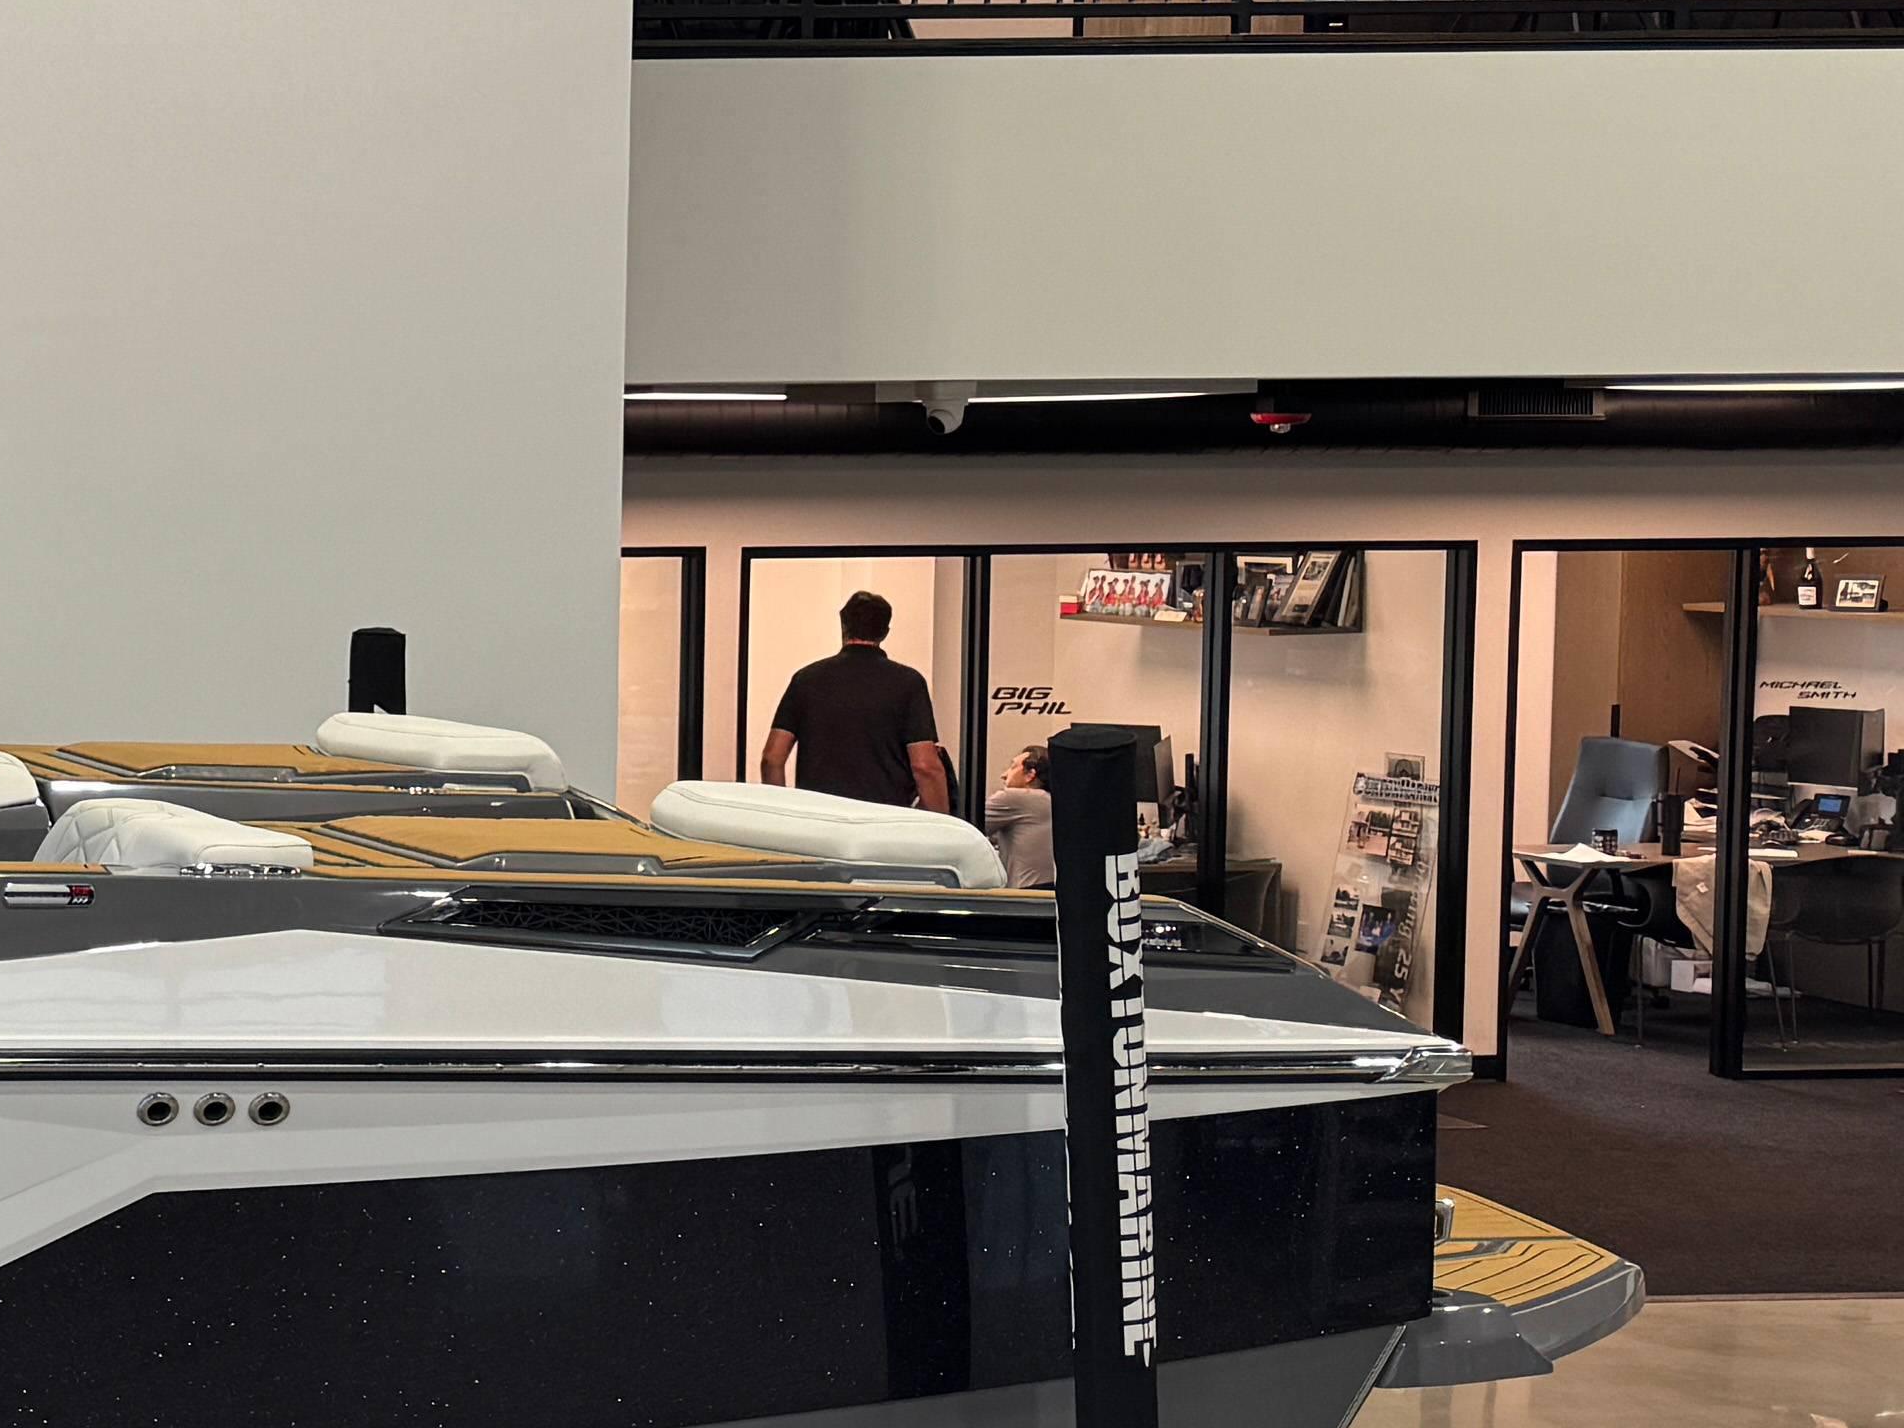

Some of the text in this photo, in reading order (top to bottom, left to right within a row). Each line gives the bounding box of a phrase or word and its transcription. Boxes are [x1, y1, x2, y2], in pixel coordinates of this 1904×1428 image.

[1759, 680, 1842, 690] MICHAEL
[991, 686, 1053, 700] BIG
[1797, 691, 1857, 700] SMITH
[995, 701, 1072, 716] PHIL
